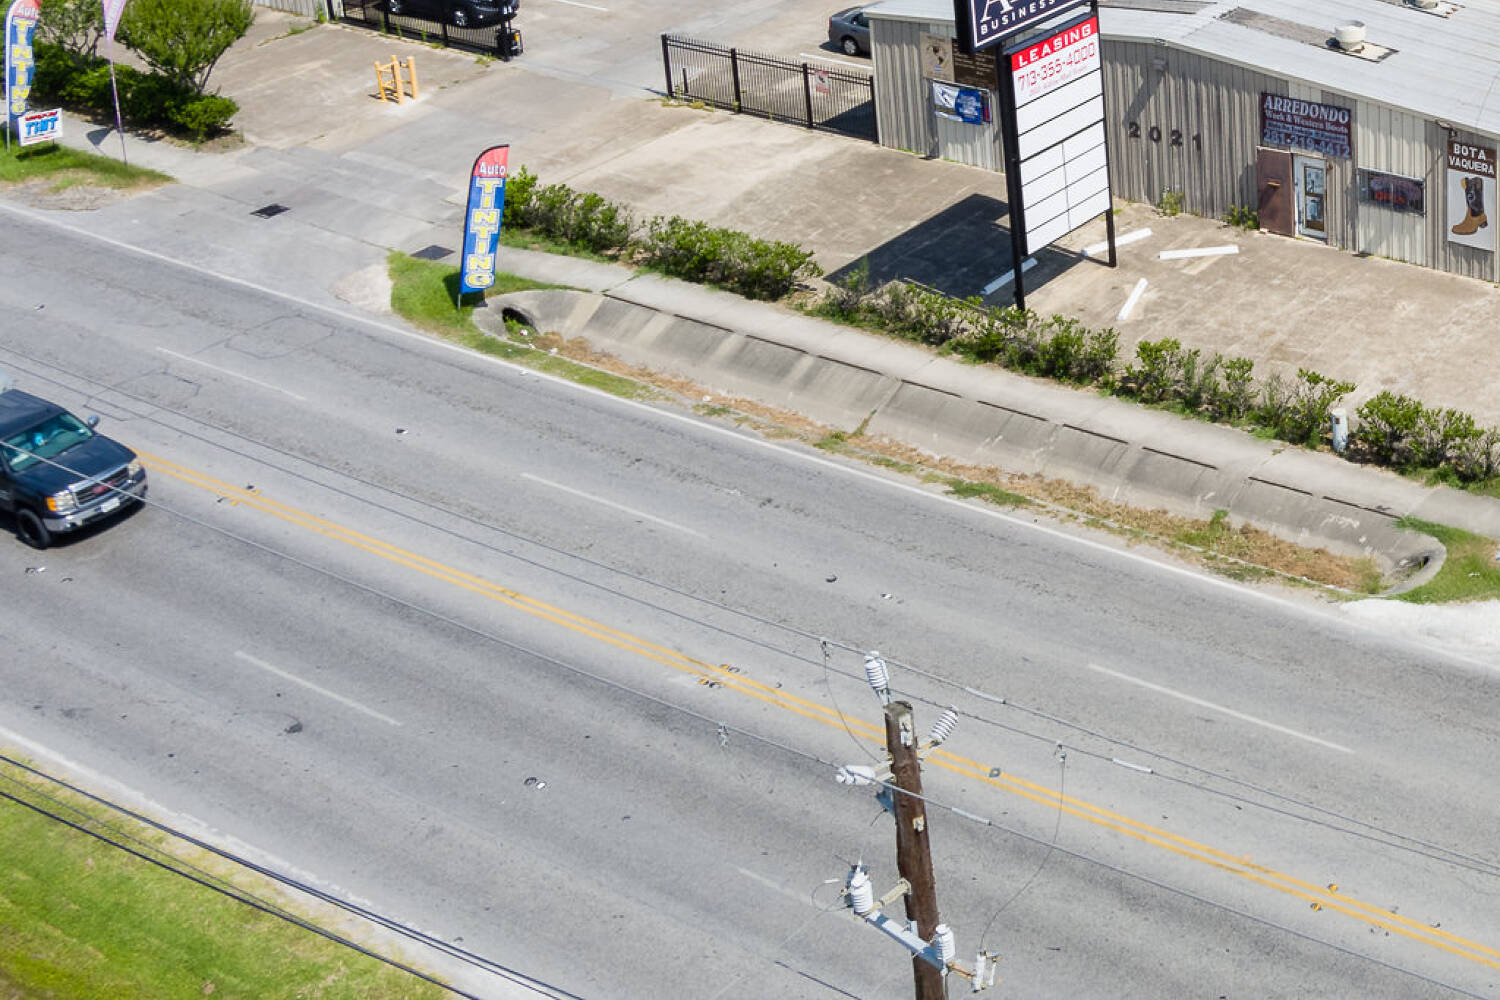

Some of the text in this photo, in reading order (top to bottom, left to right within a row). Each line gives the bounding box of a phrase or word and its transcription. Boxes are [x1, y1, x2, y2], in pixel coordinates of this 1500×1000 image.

[17, 6, 40, 18] Auto
[1018, 23, 1091, 68] LEASING
[12, 18, 37, 115] TINTING
[1264, 95, 1349, 124] ARREDONDO
[1128, 121, 1202, 151] 2021
[1294, 115, 1324, 129] Western
[1325, 122, 1349, 134] Boots
[1453, 143, 1486, 160] BOTA
[479, 161, 506, 175] Auto
[1448, 155, 1494, 175] VAQUERA
[464, 177, 503, 289] TINTING
